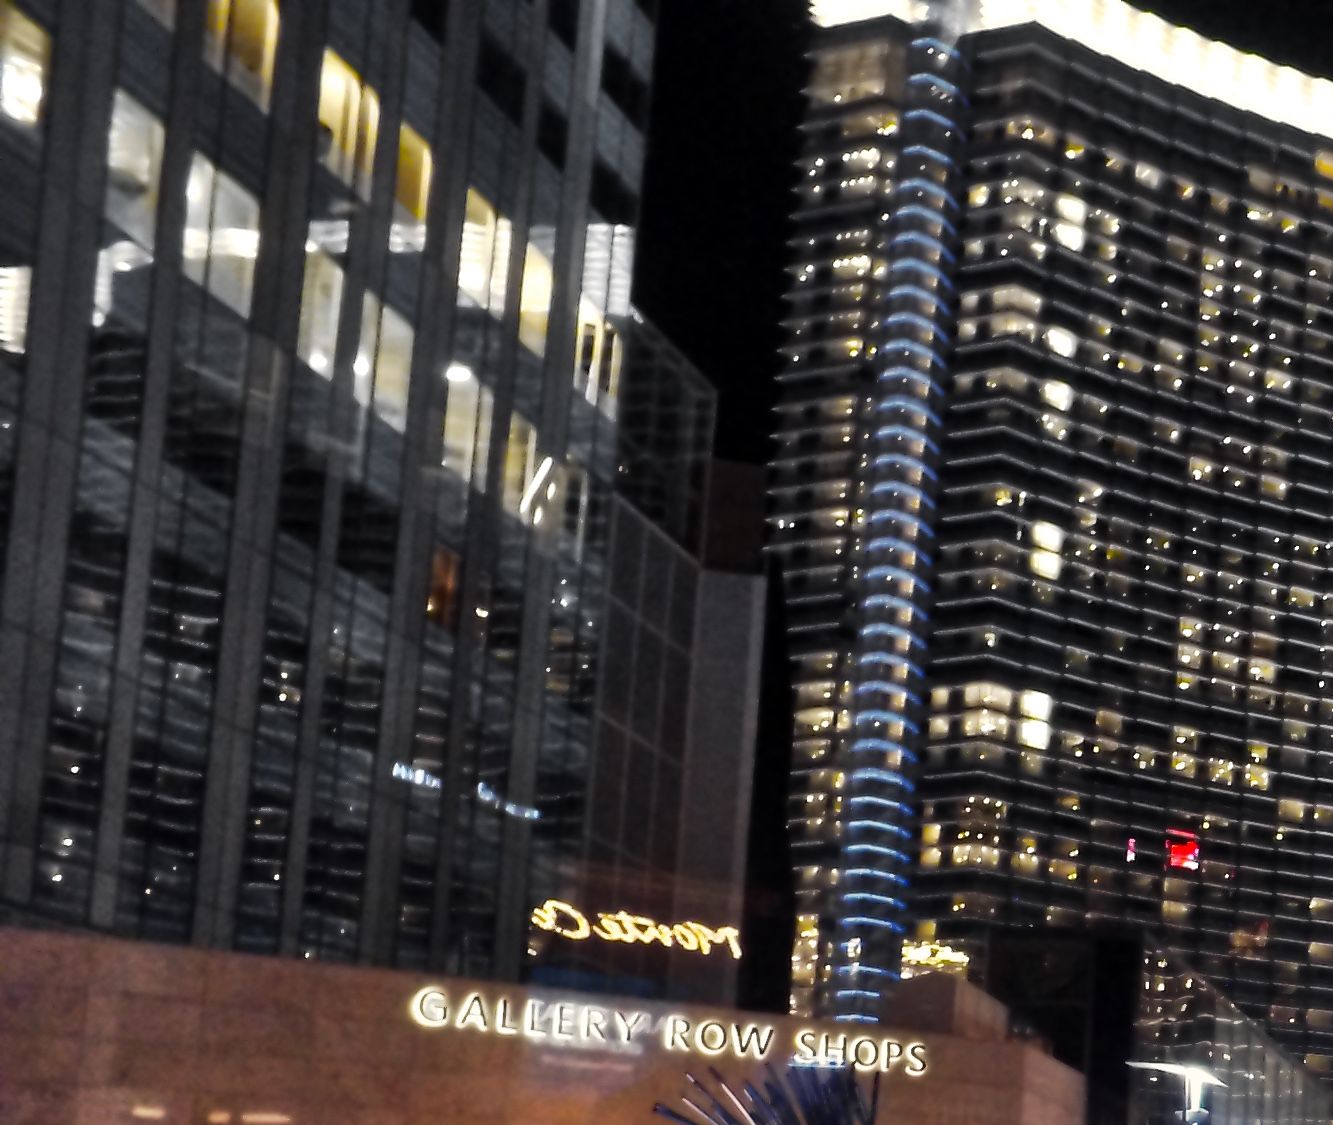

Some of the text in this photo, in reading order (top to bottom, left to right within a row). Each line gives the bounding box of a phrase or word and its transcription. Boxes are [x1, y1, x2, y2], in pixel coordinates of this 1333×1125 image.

[410, 984, 928, 1077] GALLERY ROW SHOPS
